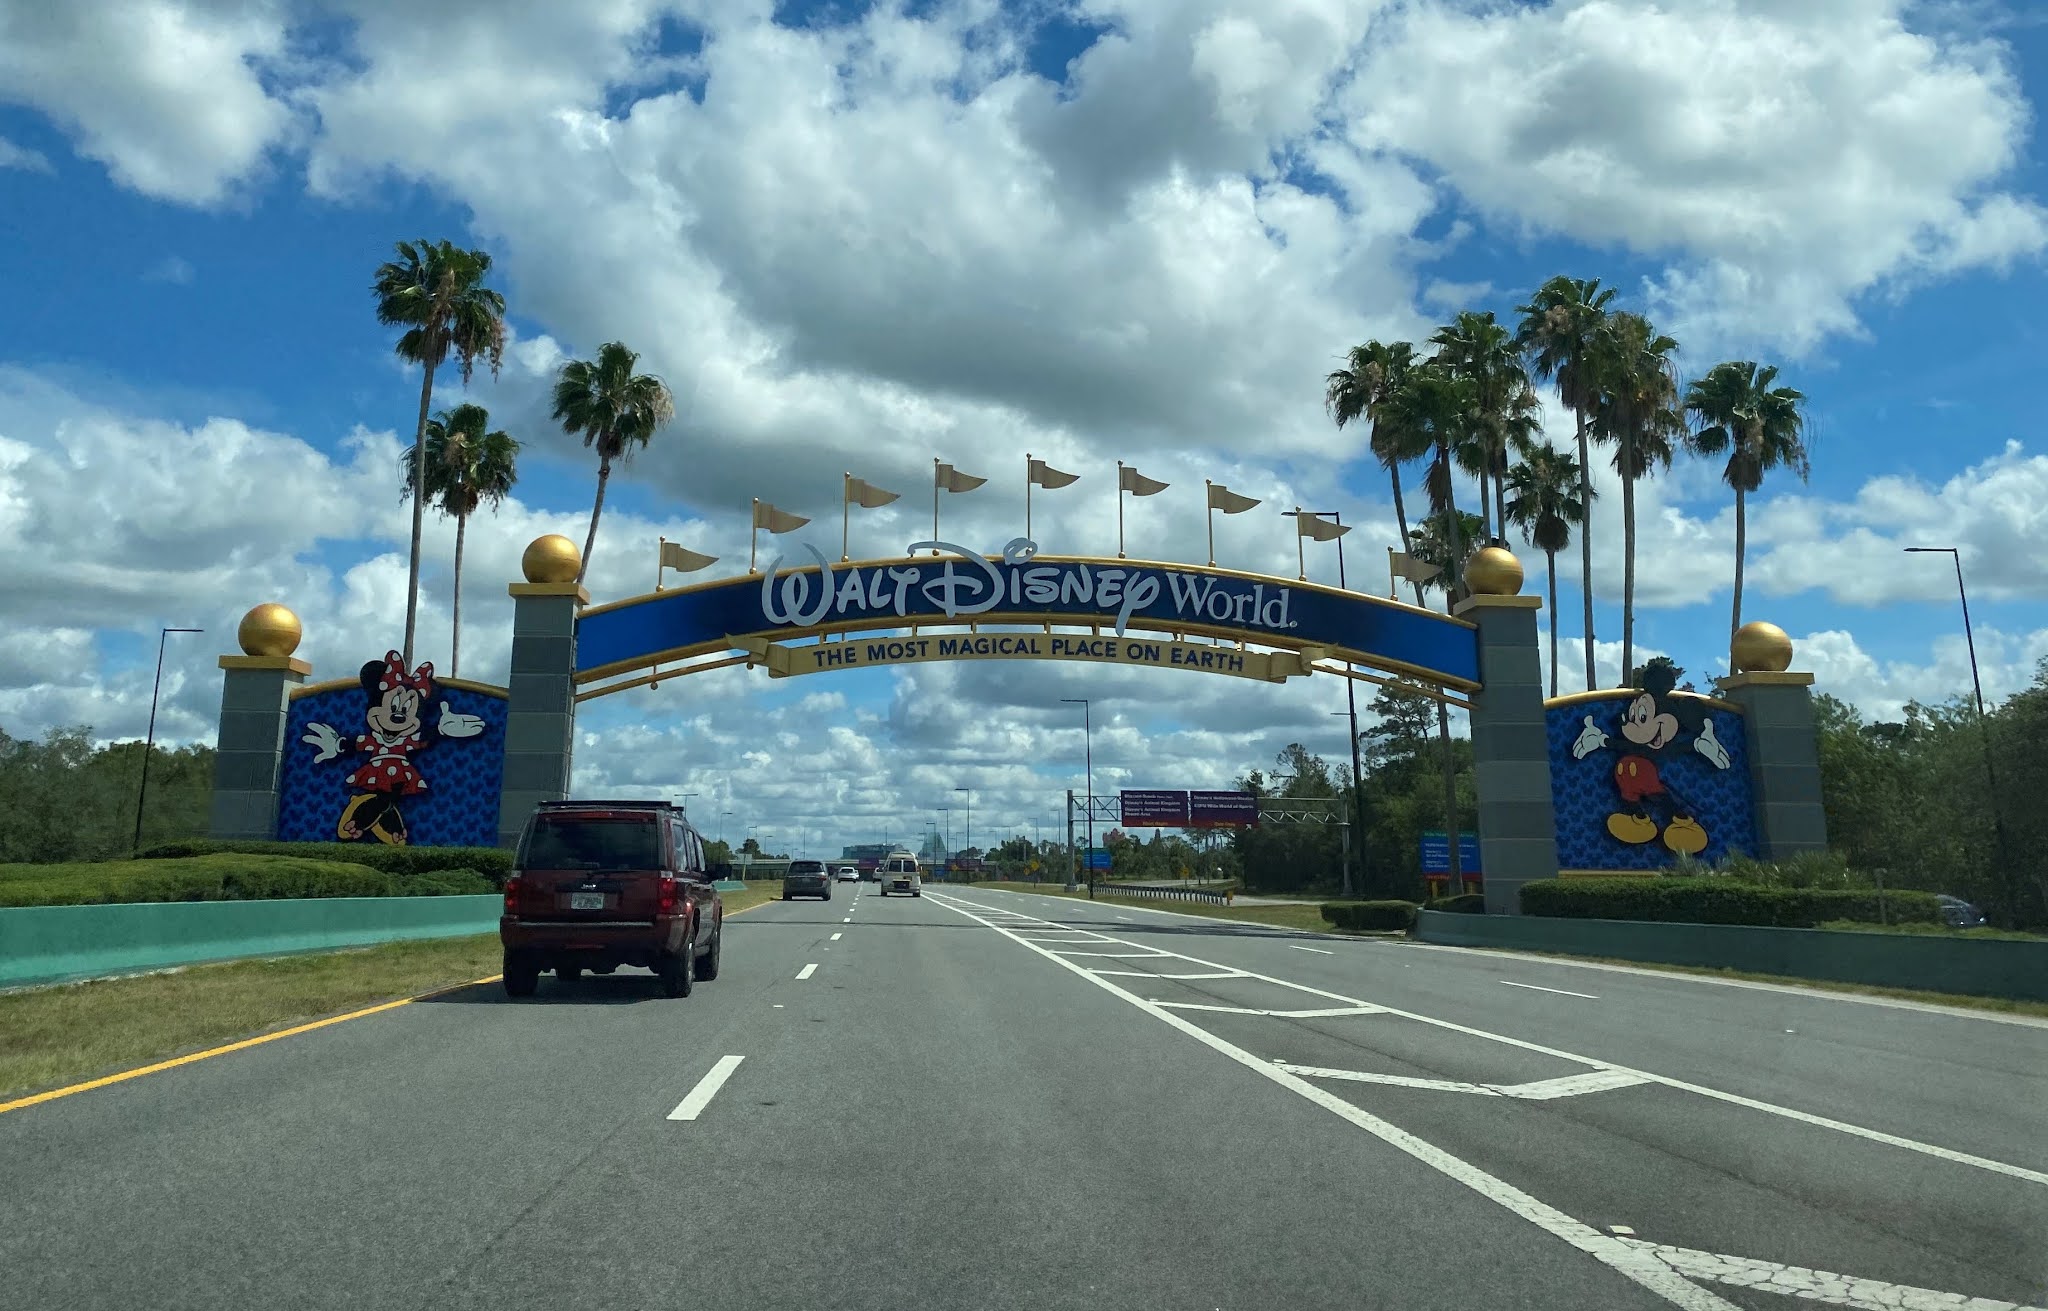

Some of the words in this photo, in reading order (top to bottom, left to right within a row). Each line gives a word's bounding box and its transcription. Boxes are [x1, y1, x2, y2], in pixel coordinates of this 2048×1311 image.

[813, 647, 857, 667] THE
[868, 640, 929, 661] MOST
[939, 637, 1041, 656] MAGICAL
[1051, 638, 1117, 658] PLACE
[1127, 643, 1160, 662] ON
[1170, 647, 1244, 672] EARTH
